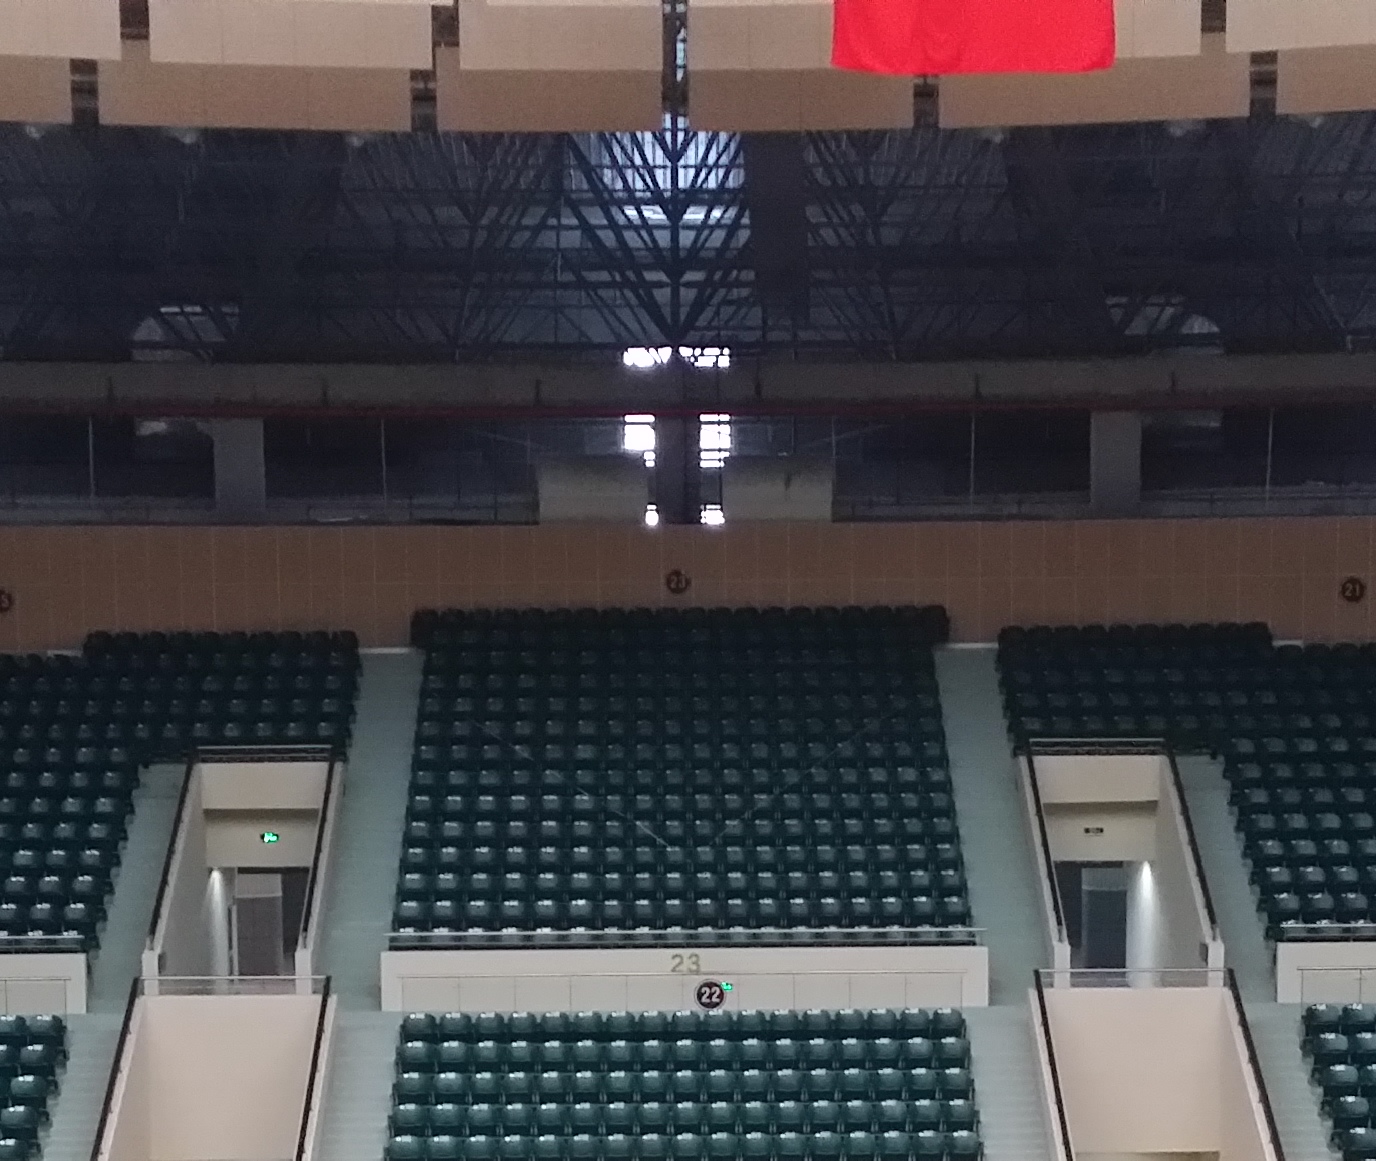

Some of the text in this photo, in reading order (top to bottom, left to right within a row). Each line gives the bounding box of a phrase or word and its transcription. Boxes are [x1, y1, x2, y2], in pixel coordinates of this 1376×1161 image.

[1345, 582, 1361, 597] 21
[670, 953, 701, 975] 23
[700, 987, 721, 1004] 22
